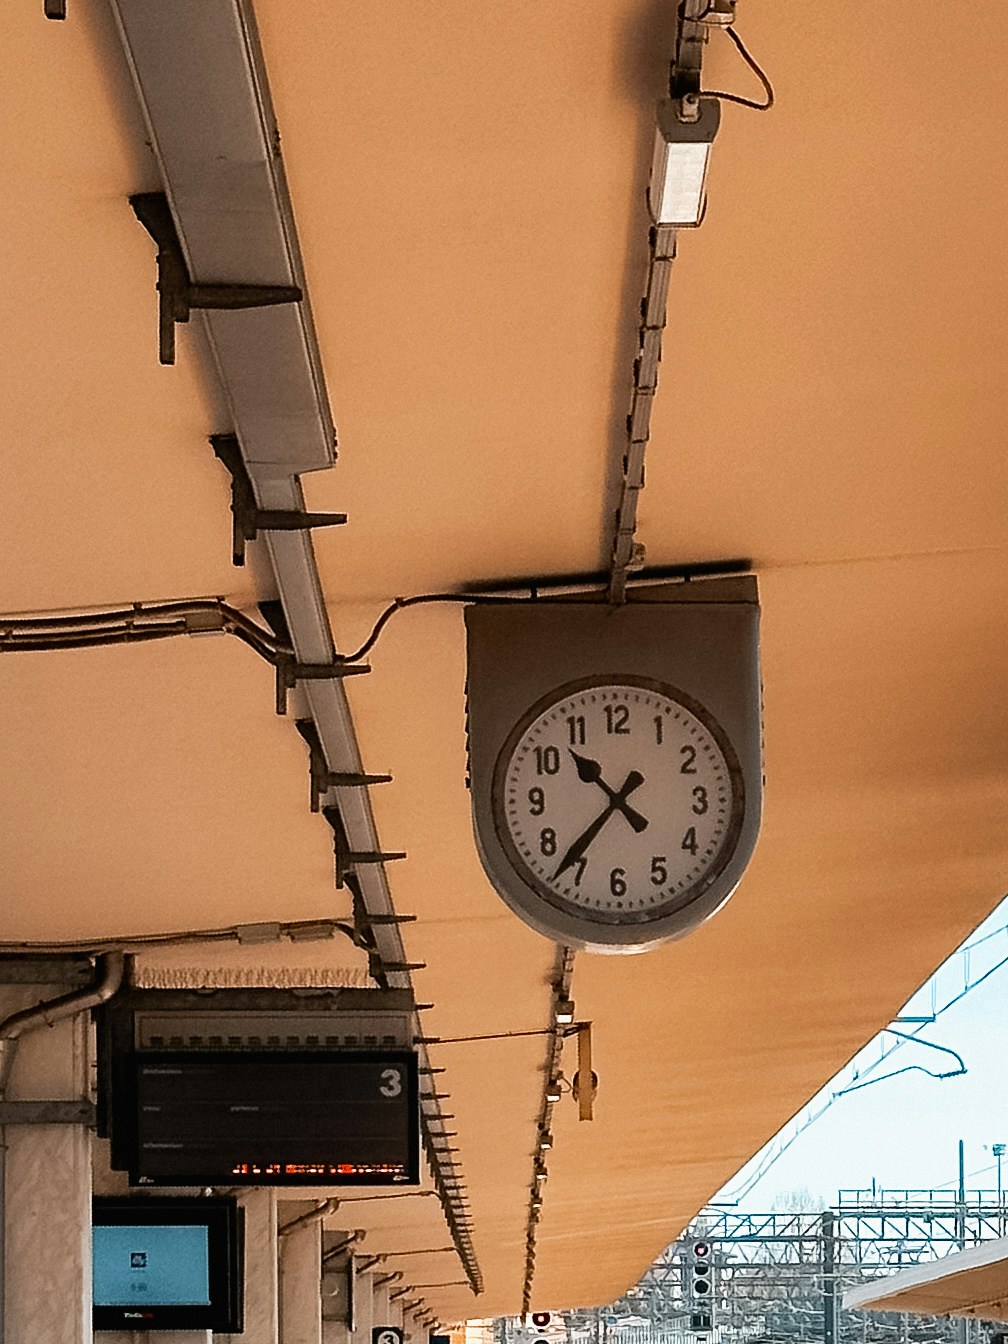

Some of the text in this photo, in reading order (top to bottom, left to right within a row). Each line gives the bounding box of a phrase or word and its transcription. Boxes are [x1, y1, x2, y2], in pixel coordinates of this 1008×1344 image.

[566, 716, 586, 745] 11
[603, 704, 631, 734] 12
[653, 716, 663, 745] 1
[533, 746, 560, 775] 10
[680, 745, 697, 774] 2
[528, 787, 545, 816] 9
[692, 786, 708, 815] 3
[540, 828, 557, 857] 8
[681, 827, 699, 857] 4
[571, 857, 588, 887] 7
[610, 868, 627, 897] 6
[650, 857, 668, 886] 5
[379, 1068, 402, 1098] 3
